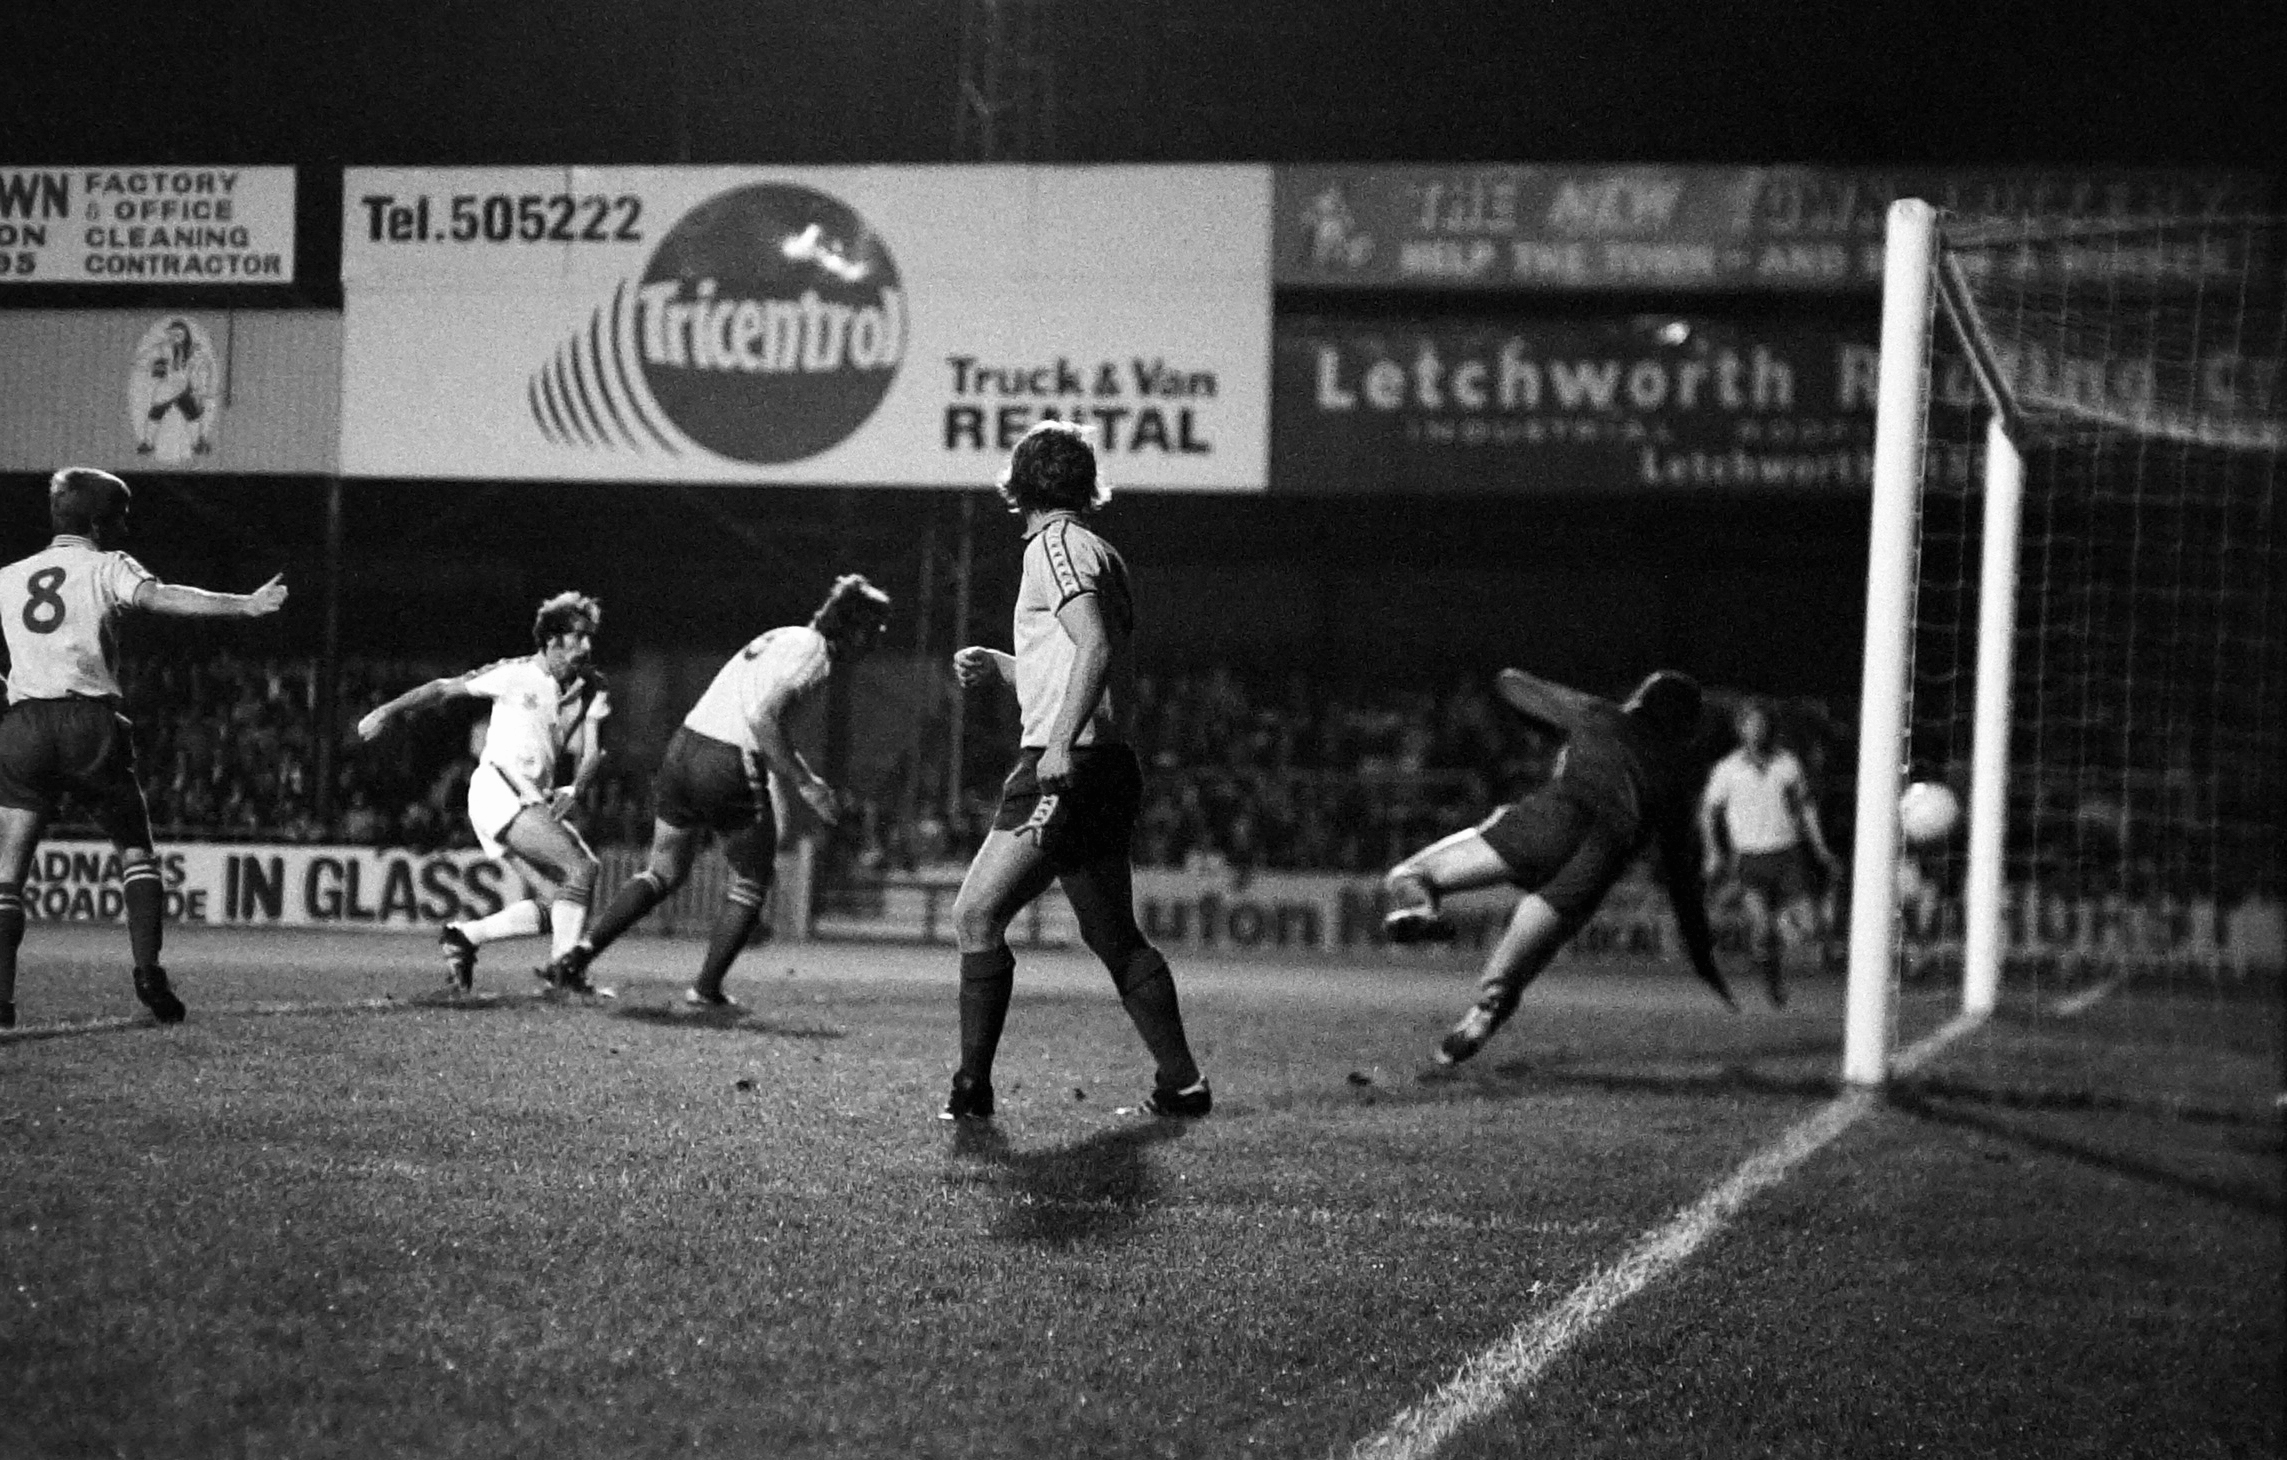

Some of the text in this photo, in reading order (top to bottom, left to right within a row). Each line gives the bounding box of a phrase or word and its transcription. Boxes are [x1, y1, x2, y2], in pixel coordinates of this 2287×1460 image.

[85, 172, 239, 194] FACTORY
[114, 200, 234, 221] OFFICE
[84, 226, 249, 248] CLEANING
[84, 253, 282, 275] CONTRACTOR
[637, 279, 905, 371] Tricentrol
[946, 356, 1218, 397] Truck & Van
[1315, 338, 1794, 410] Letchworth
[944, 405, 1212, 452] RETAL
[22, 566, 66, 634] 8
[28, 852, 186, 888] ADNAS
[225, 855, 503, 922] IN GLASS
[23, 886, 208, 918] ROADDE
